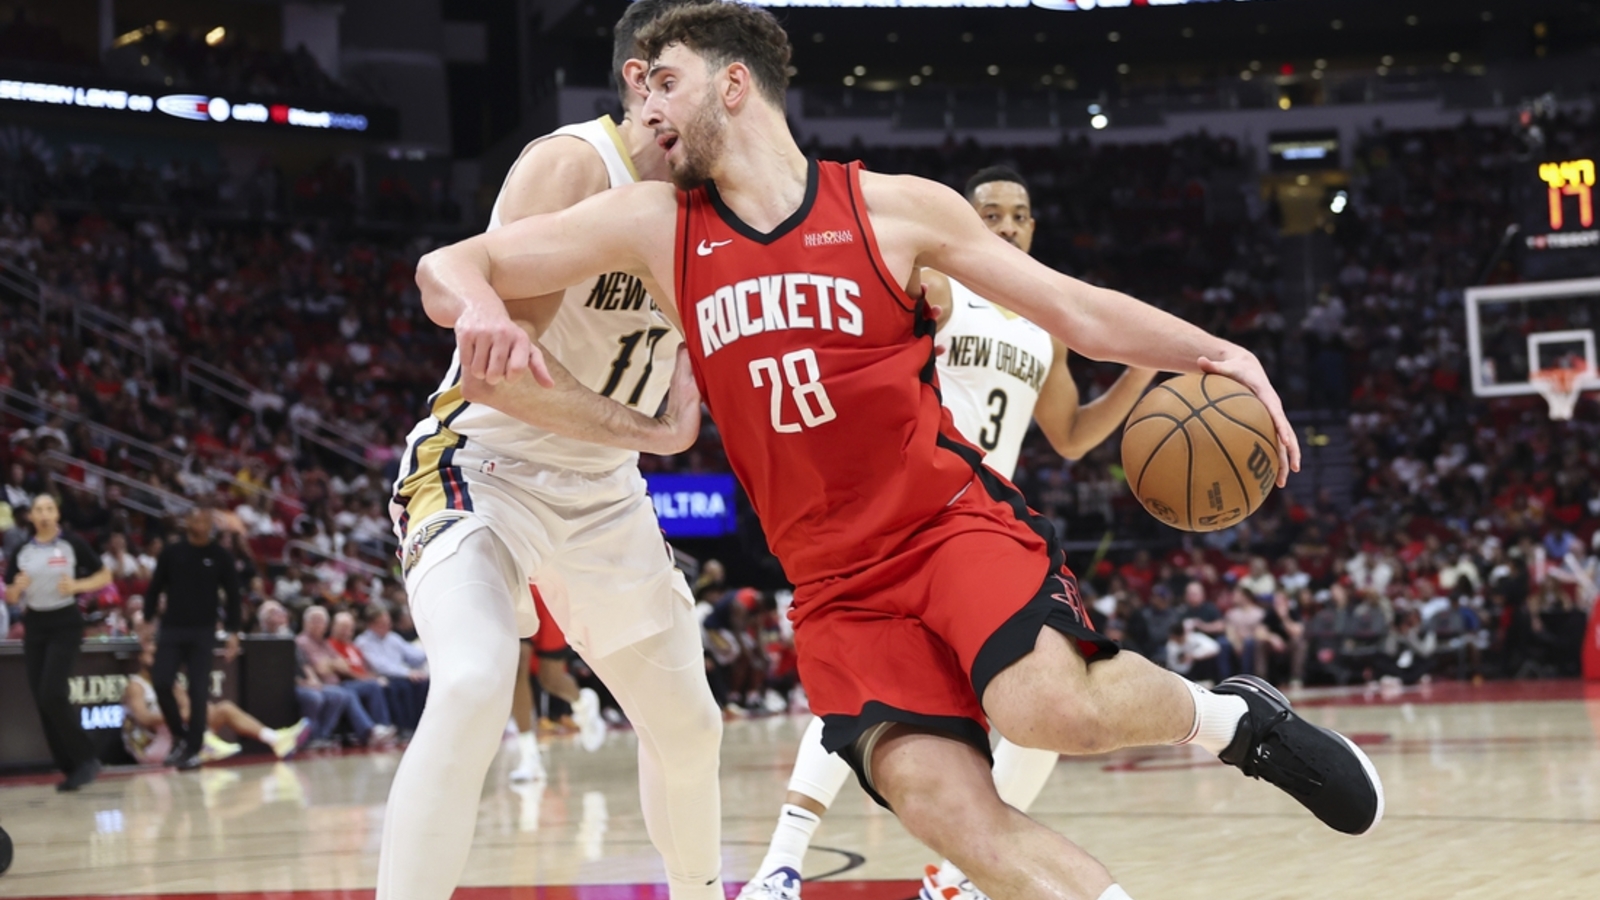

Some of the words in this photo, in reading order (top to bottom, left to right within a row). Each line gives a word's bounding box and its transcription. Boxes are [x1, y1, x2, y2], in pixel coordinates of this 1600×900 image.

[583, 271, 647, 311] NEW
[696, 273, 864, 358] ROCKETS
[601, 326, 671, 406] 17
[748, 348, 837, 433] 28
[947, 335, 993, 368] NEW
[995, 340, 1046, 393] ORLEAN
[979, 388, 1008, 452] 3
[81, 705, 124, 730] LAKE
